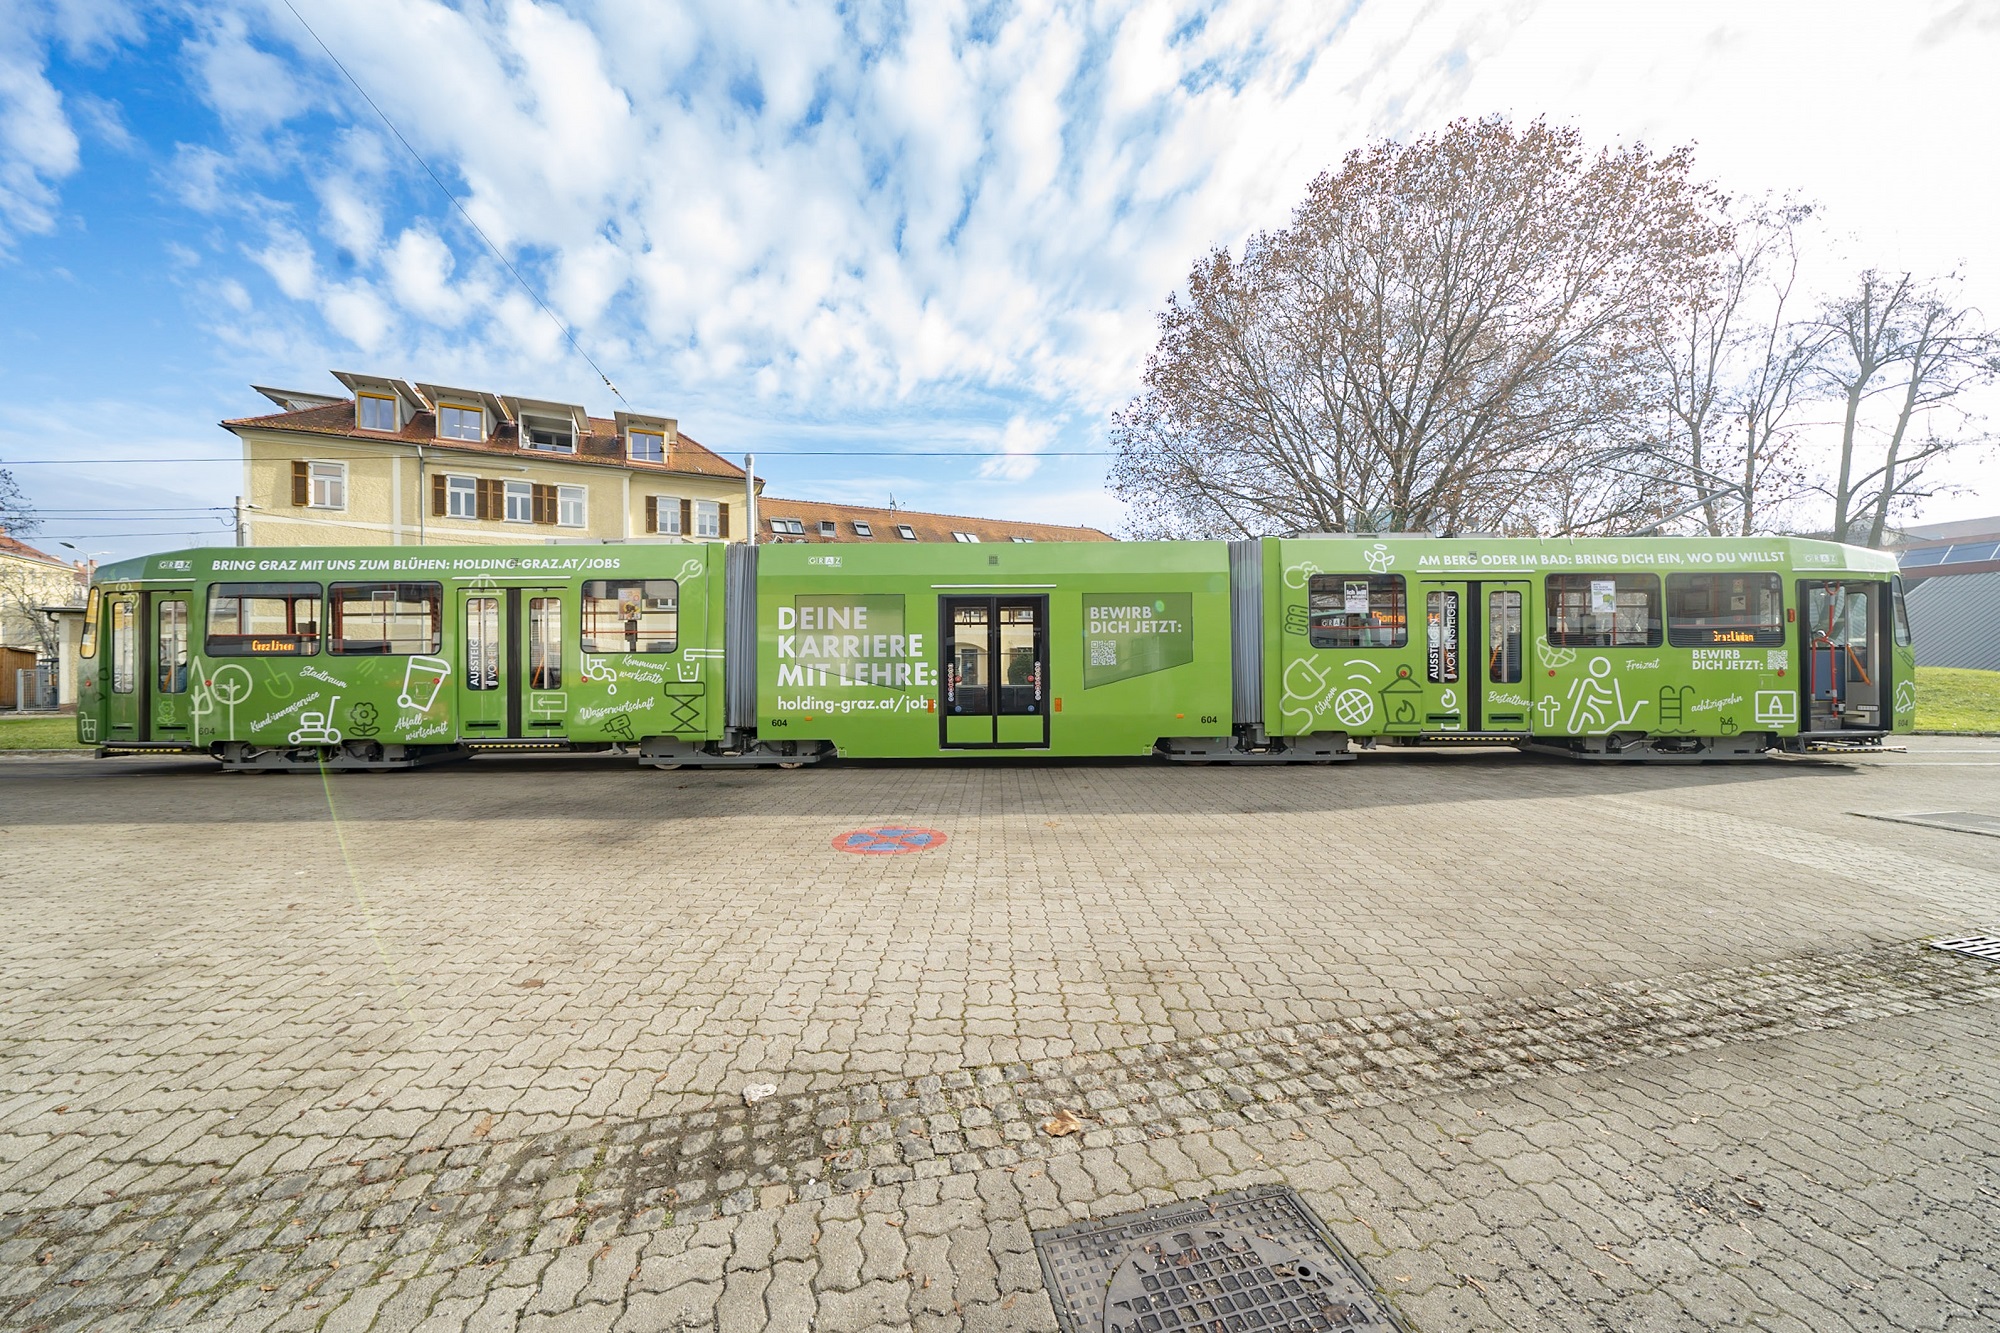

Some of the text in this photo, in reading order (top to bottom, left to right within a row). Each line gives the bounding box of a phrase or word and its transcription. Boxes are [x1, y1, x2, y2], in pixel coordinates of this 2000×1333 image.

[159, 560, 192, 569] GRAZ
[212, 557, 621, 571] BRING GRAZ MIT UNS ZUM BLÜHEN: HOLDING-GRAZ.AT/JOBS
[808, 556, 842, 565] GRAZ
[1418, 552, 1785, 565] AM BERG ODER IM BAD: BRING DICH EIN, WO DU WILLST
[778, 606, 867, 630] DEINE
[1090, 606, 1152, 619] BEWIRB
[1090, 620, 1182, 634] DICH JETZT:
[1446, 596, 1456, 671] VOR EINSTEIGEN
[778, 634, 923, 658] KARRIERE
[622, 654, 670, 671] Kommunal-
[1692, 650, 1740, 660] BEWIRB
[1626, 658, 1660, 671] Freizeit
[1692, 660, 1764, 670] DICH JETZT:
[299, 665, 347, 688] Stadtraum
[777, 662, 938, 686] MIT LEHRE:
[580, 697, 655, 720] Wasserwirtschaft
[1314, 686, 1338, 715] Citycom
[1488, 690, 1534, 711] Bestattung
[1691, 693, 1743, 712] achtzigzehn
[199, 727, 215, 735] 604
[406, 721, 448, 741] wirtschaft
